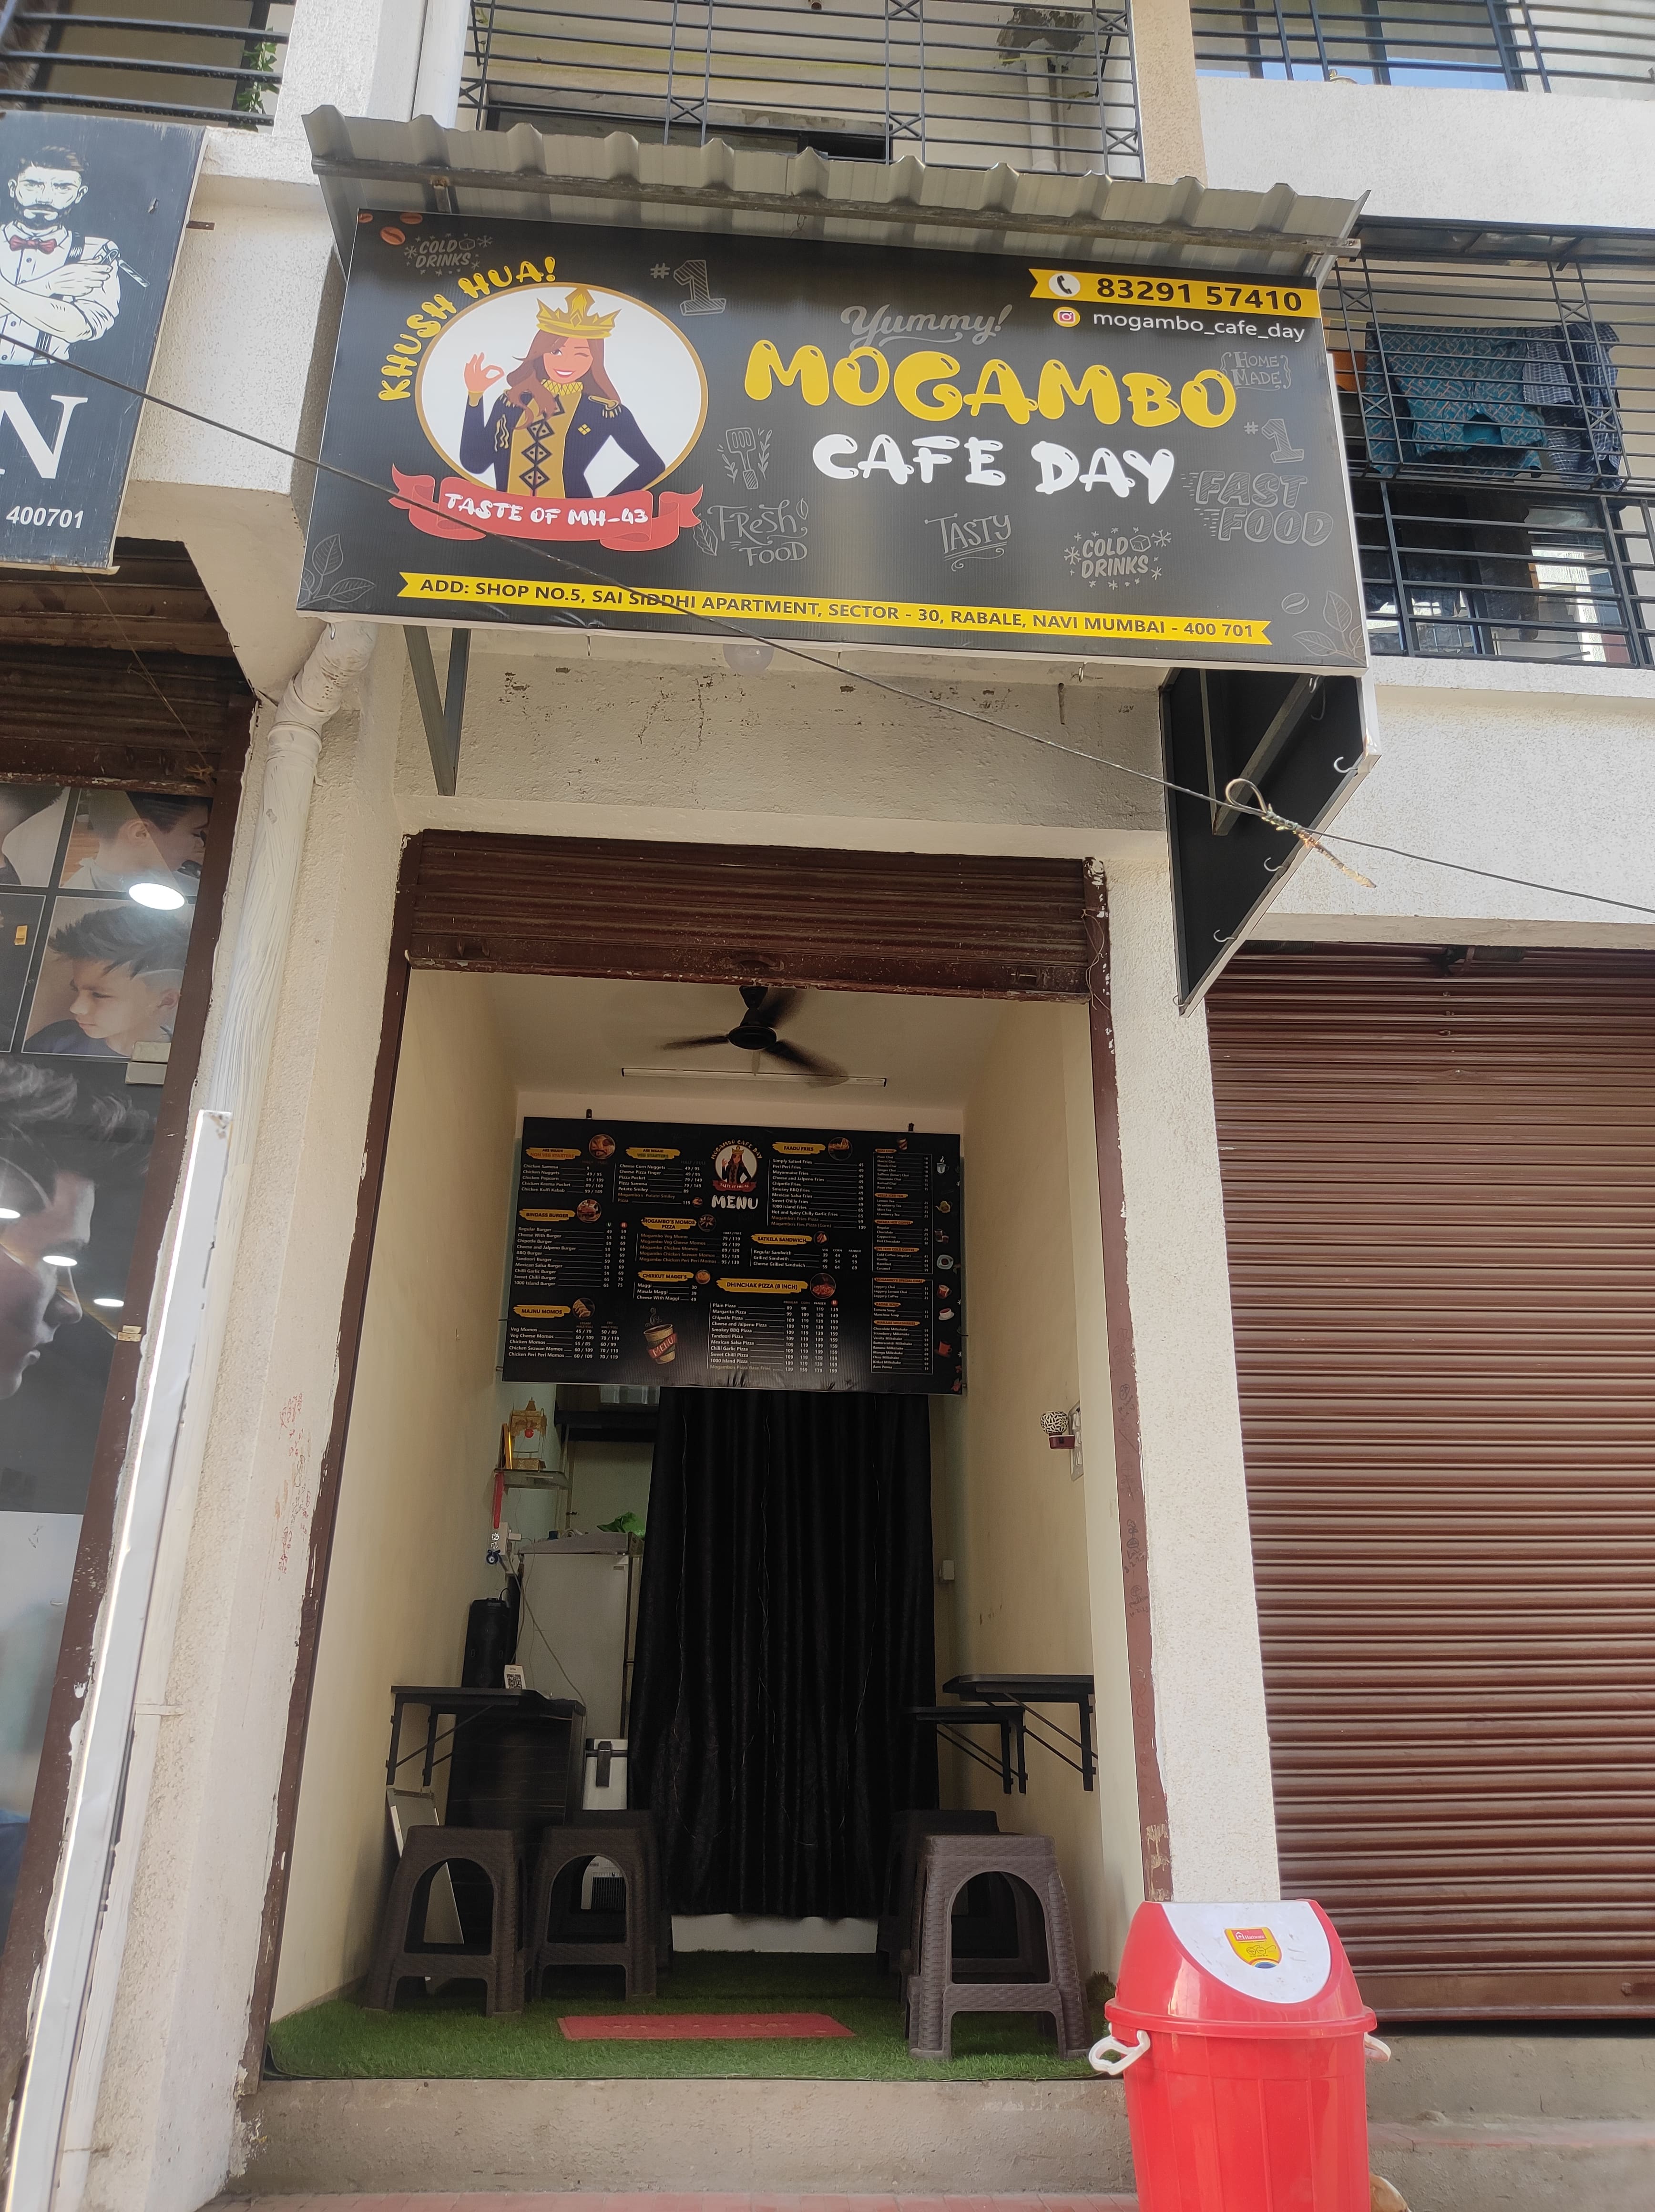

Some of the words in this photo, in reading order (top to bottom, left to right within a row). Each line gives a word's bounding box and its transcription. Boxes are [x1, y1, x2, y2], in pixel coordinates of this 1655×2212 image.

[415, 252, 471, 268] DRINKS
[419, 240, 456, 254] COLD
[1097, 278, 1191, 303] 83291
[1206, 286, 1301, 311] 57410
[378, 294, 458, 401] KHUSH
[458, 256, 555, 299] HUA!
[840, 303, 1012, 349] Yummy!
[1093, 312, 1305, 342] mogambo_cafe_day
[1234, 351, 1278, 368] HOME
[744, 339, 1236, 428] MOGAMBO
[1233, 369, 1282, 386] MADE
[812, 434, 1006, 486] CAFE
[1031, 440, 1175, 503] DAY
[1195, 471, 1308, 508] FAST
[6, 505, 83, 528] 400701
[444, 493, 523, 522] TASTE
[531, 507, 561, 524] OF
[568, 509, 648, 526] MH-43
[924, 513, 1011, 554] TASTY
[1218, 507, 1334, 546] FOOD
[1083, 537, 1128, 558] COLD
[1082, 555, 1148, 578] DRINKS
[420, 579, 469, 594] ADD:
[475, 583, 528, 598] SHOP
[535, 587, 585, 604] NO.5,
[592, 590, 622, 604] SAI
[629, 592, 695, 609] SIDDHI
[702, 596, 822, 617] APARTMENT,
[828, 604, 899, 619] SECTOR
[918, 609, 944, 624] 30,
[951, 611, 1026, 628] RABALE,
[1033, 615, 1077, 629] NAVI
[1085, 618, 1165, 633] MUMBAI
[1184, 623, 1216, 635] 400
[1224, 625, 1252, 637] 701
[711, 1195, 758, 1209] MENU
[653, 1337, 673, 1356] MENU
